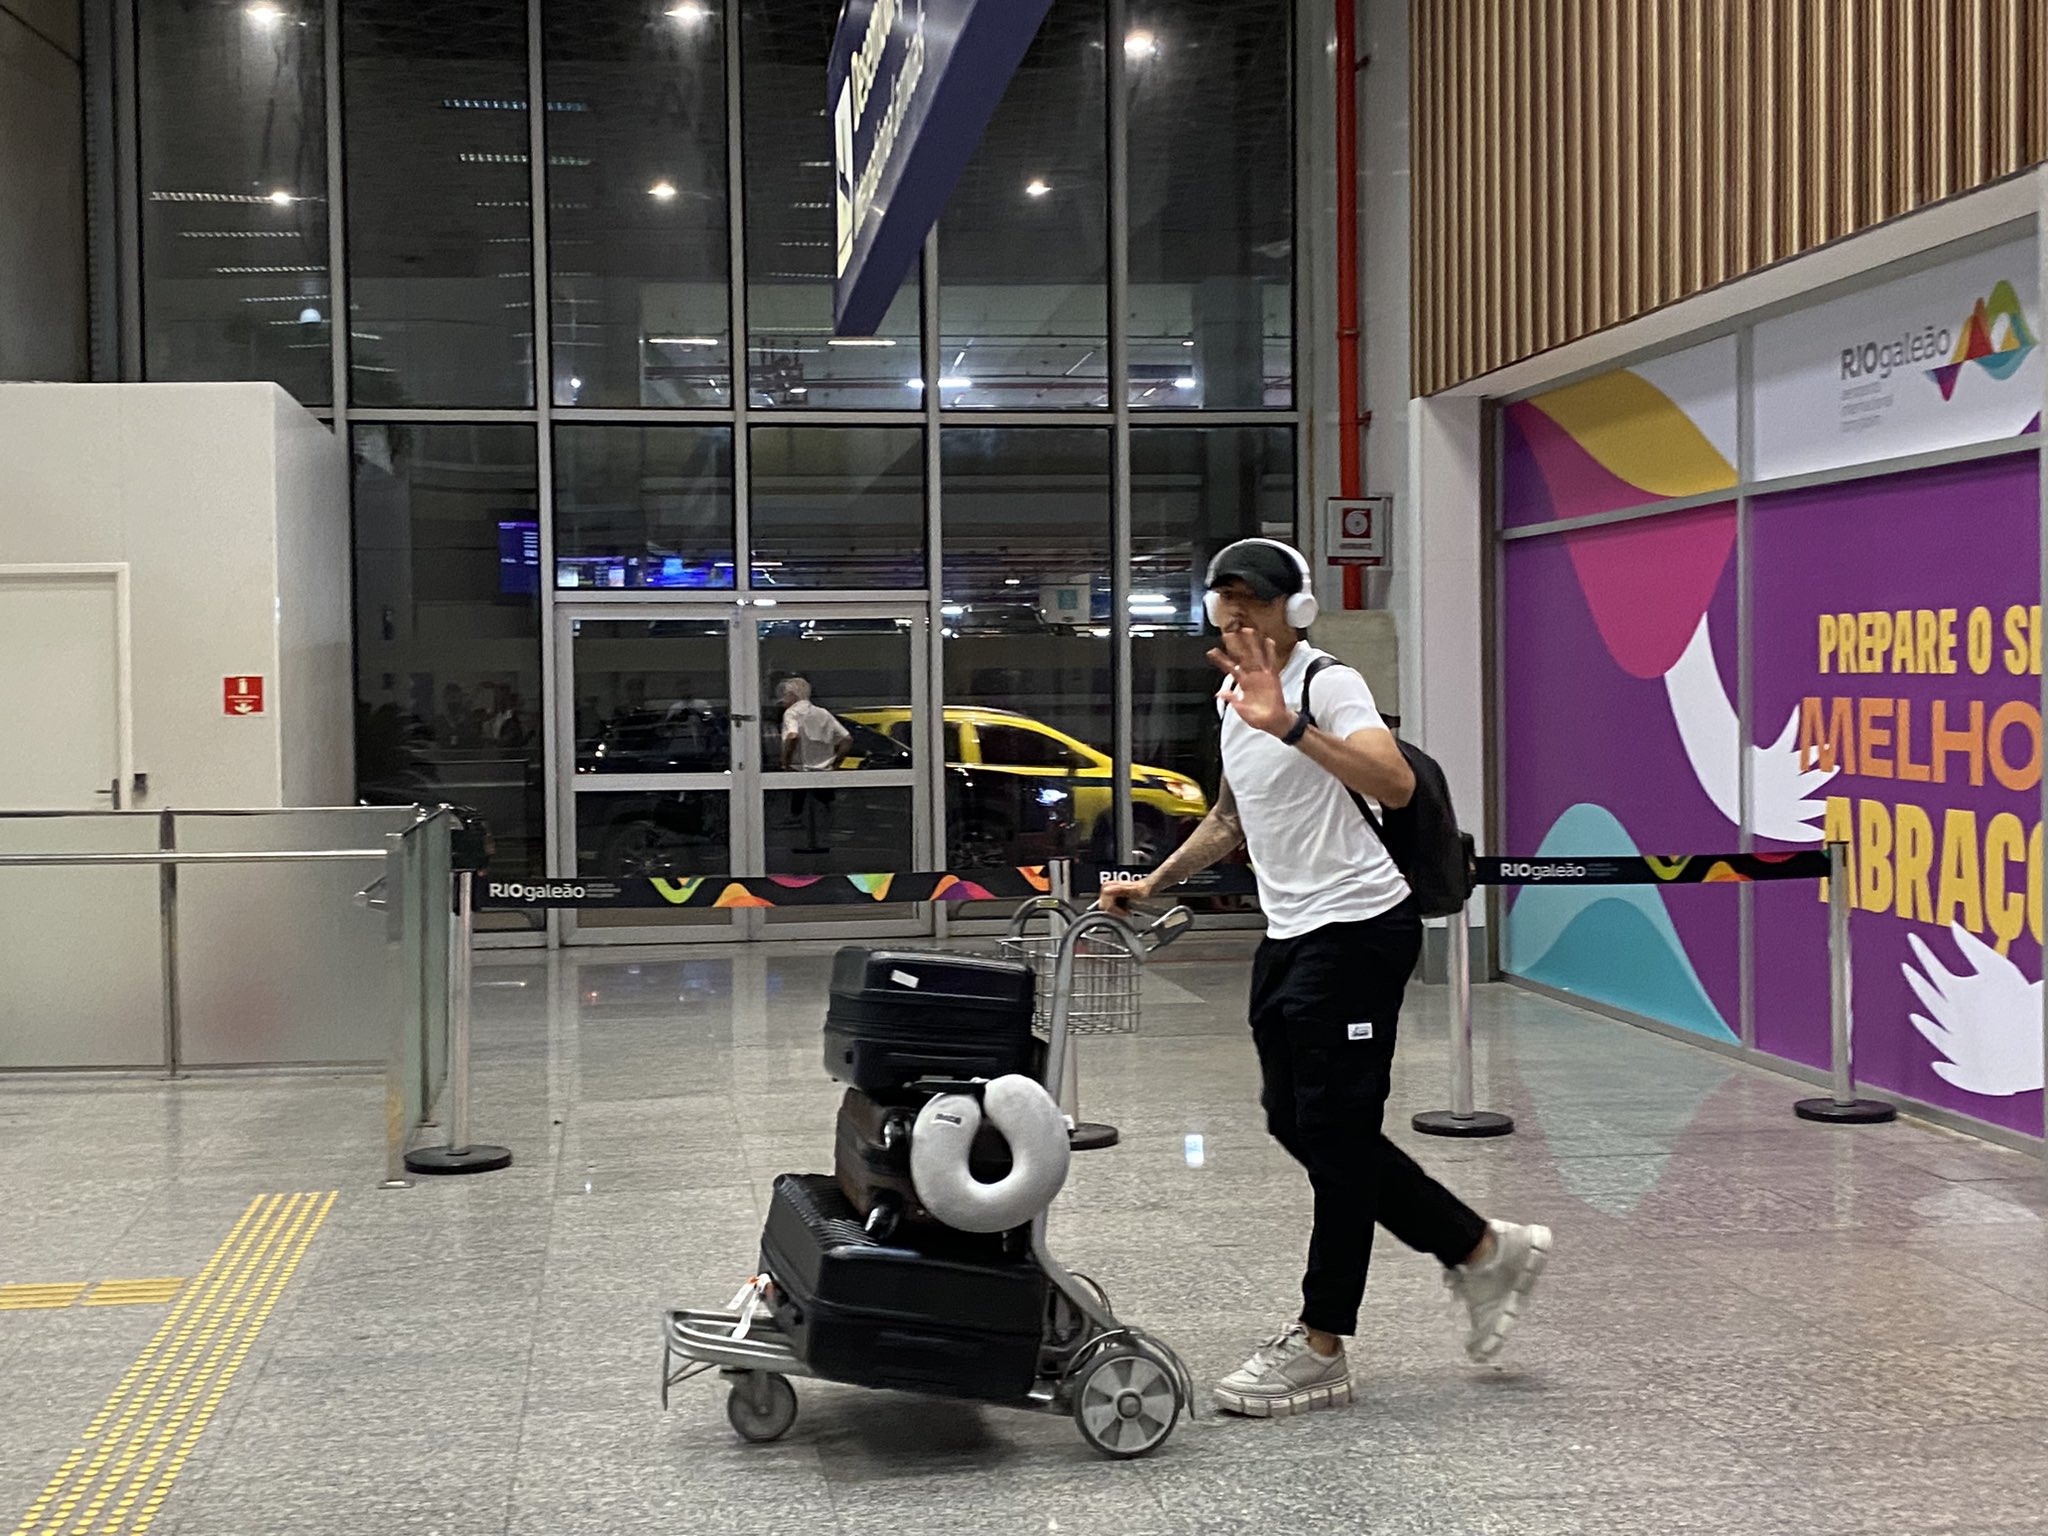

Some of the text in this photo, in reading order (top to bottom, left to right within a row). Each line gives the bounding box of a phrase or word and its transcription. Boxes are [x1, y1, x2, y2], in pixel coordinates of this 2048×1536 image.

[1841, 325, 1951, 380] RIOgaleão
[1819, 608, 1957, 674] PREPARE
[1968, 606, 1992, 675] O
[1800, 697, 2043, 791] MELHO
[489, 883, 585, 902] RIOgaleão
[1500, 863, 1586, 880] RIOgaleão
